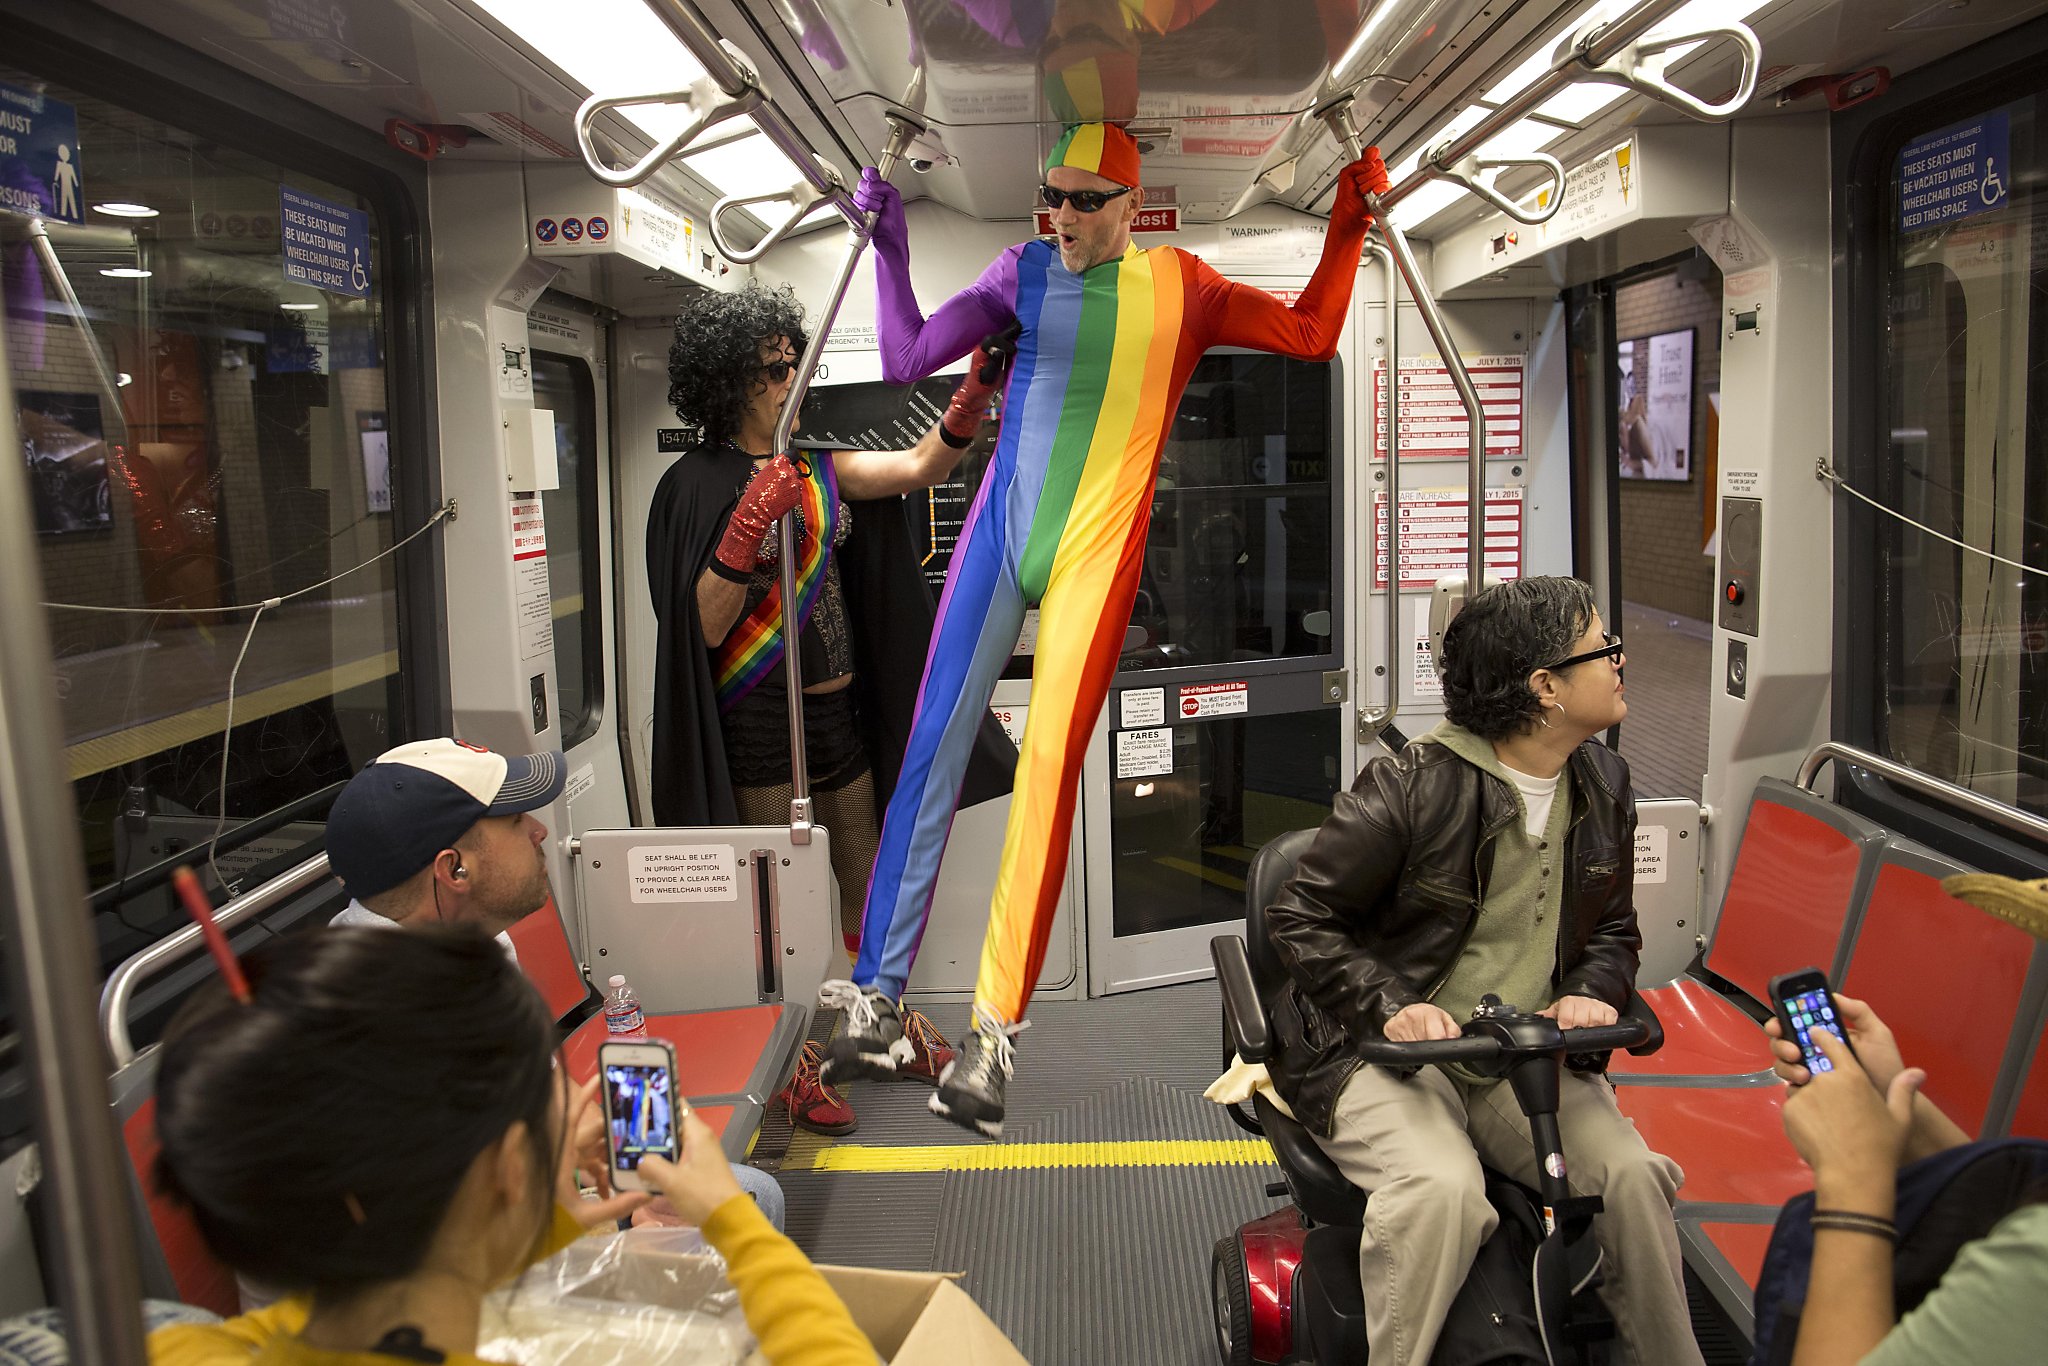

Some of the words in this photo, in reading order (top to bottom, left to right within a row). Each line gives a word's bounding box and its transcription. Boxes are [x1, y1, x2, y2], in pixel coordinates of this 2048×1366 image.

[1904, 161, 1925, 177] THESE
[1928, 152, 1951, 170] SEATS
[1953, 143, 1976, 162] MUST
[1904, 182, 1912, 194] BE
[1913, 170, 1948, 190] VACATED
[1950, 162, 1974, 180] WHEN
[0, 186, 41, 210] RSONS
[1903, 188, 1950, 211] WHEELCHAIR
[1952, 179, 1978, 196] USERS
[285, 209, 306, 225] THESE
[307, 216, 327, 232] SEATS
[329, 222, 346, 237] MUST
[1131, 212, 1167, 226] uest
[1903, 213, 1921, 228] NEED
[1924, 209, 1940, 222] THIS
[1942, 200, 1967, 218] SPACE
[286, 227, 295, 240] BE
[296, 230, 326, 248] VACATED
[327, 239, 346, 254] WHEN
[287, 246, 329, 267] WHEELCHAIR
[330, 257, 350, 271] USERS
[288, 264, 305, 278] NEED
[308, 268, 322, 282] THIS
[323, 272, 343, 286] SPACE
[1477, 358, 1495, 366] JULY
[1504, 357, 1521, 365] 2015
[662, 433, 694, 443] 1547A
[1131, 731, 1159, 740] FARES
